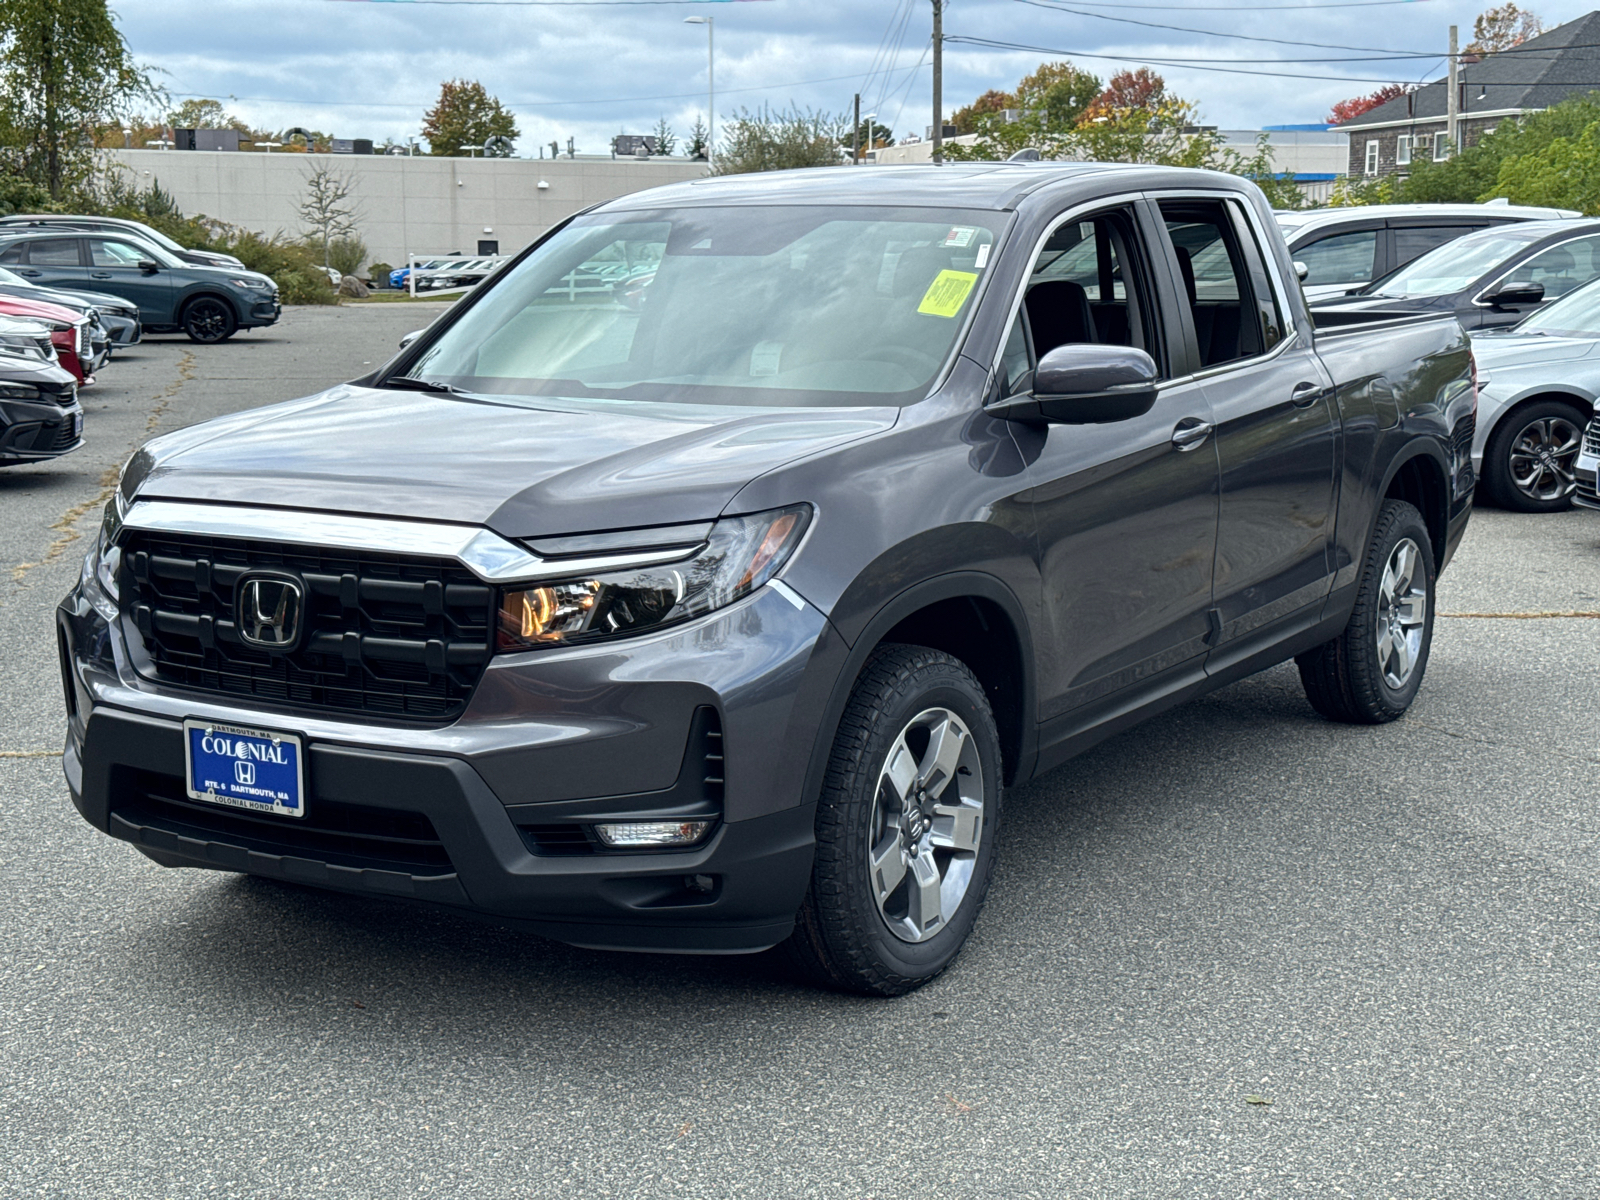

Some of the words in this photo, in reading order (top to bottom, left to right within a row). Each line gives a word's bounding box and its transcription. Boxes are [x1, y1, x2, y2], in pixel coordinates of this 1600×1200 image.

[202, 736, 288, 765] COLONIAL
[205, 780, 220, 789] RTE.
[221, 782, 226, 790] 6
[231, 784, 277, 799] DARTMOUTH,
[278, 792, 289, 800] MA
[214, 795, 248, 808] COLONIAL
[249, 801, 274, 812] HONDA
